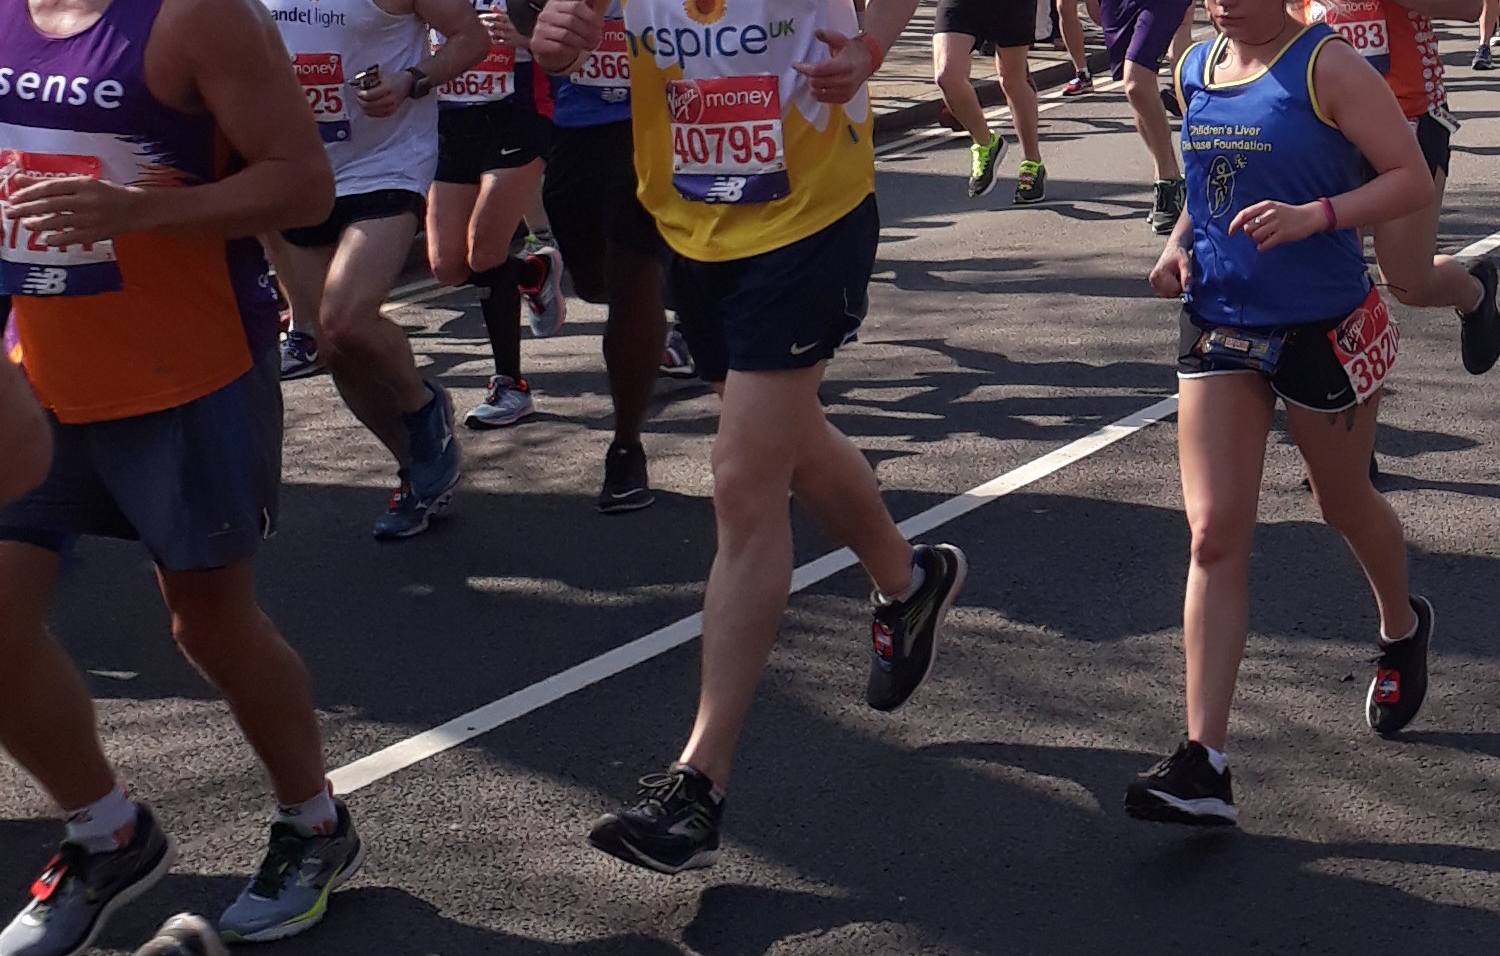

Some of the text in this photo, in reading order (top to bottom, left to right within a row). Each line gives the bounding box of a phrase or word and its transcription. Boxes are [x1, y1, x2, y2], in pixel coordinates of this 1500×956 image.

[315, 7, 346, 28] light
[0, 66, 125, 109] sense
[667, 86, 774, 121] Virgin money
[674, 124, 777, 165] 40795
[1213, 138, 1273, 152] Foundation
